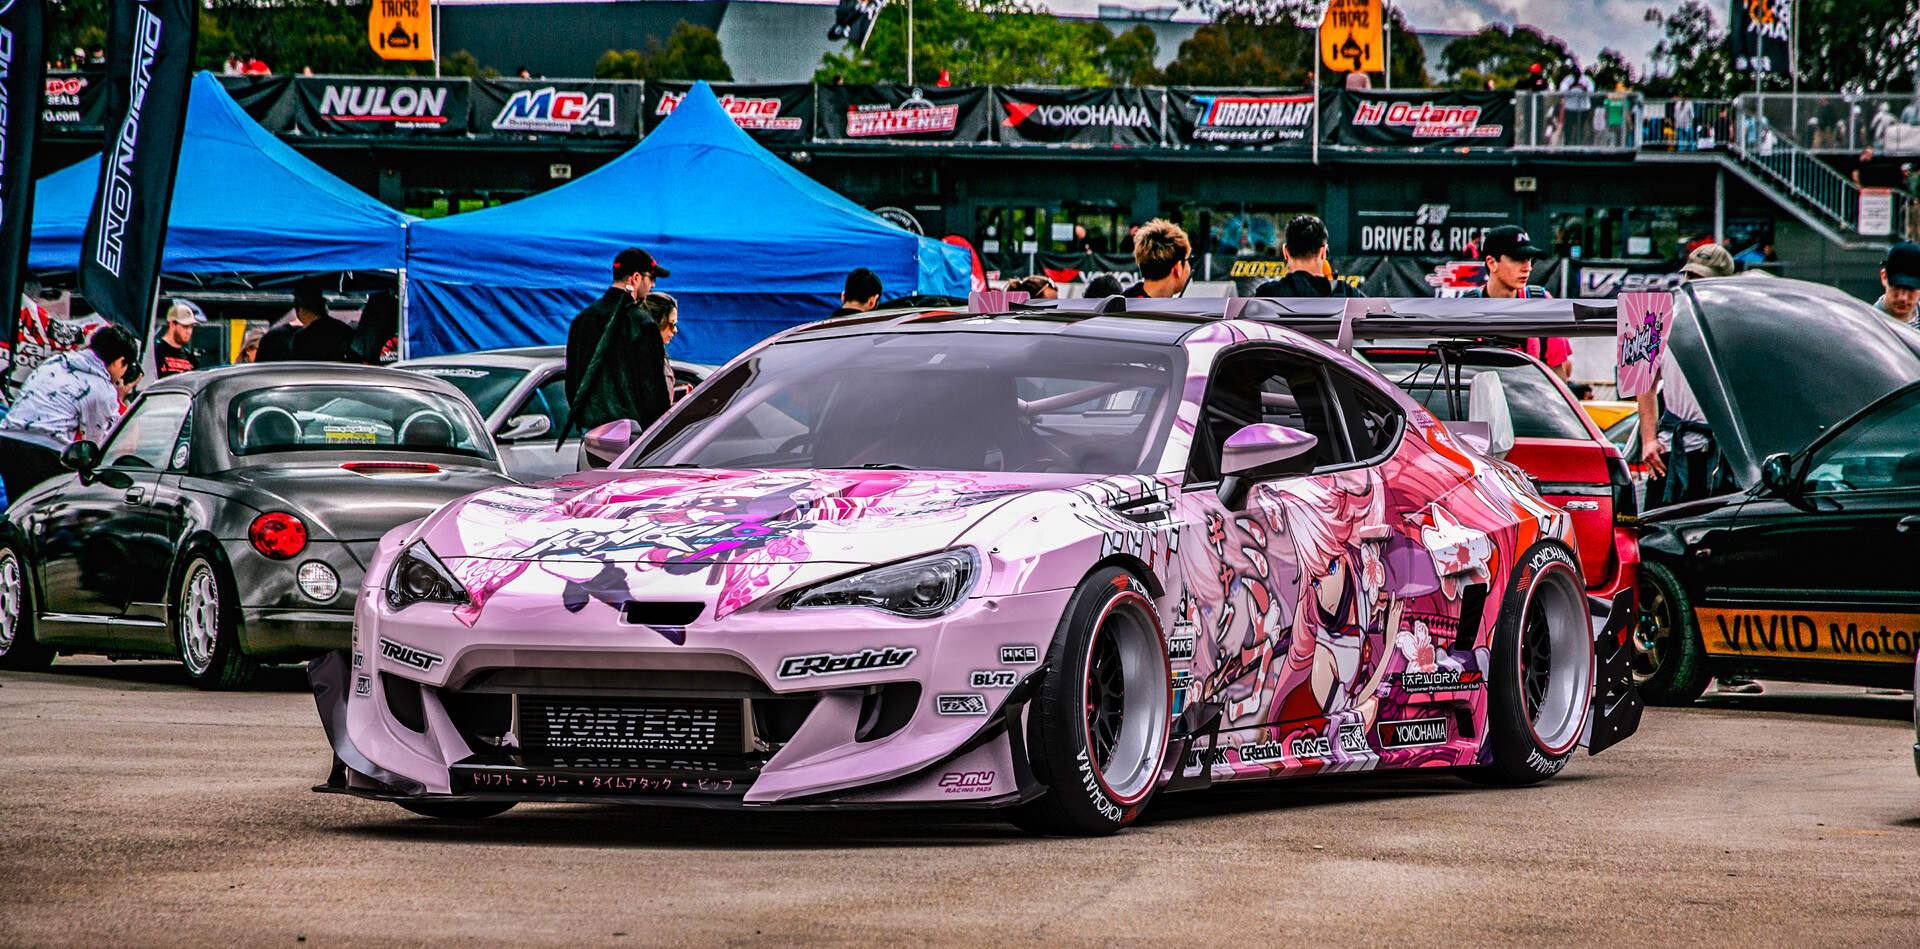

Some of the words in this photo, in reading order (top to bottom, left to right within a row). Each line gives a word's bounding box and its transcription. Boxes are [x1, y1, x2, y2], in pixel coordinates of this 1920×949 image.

[117, 10, 162, 177] DIVISION
[320, 85, 448, 116] NULON
[497, 89, 614, 126] MCA
[1038, 104, 1152, 127] YOKOHAMA
[1192, 95, 1314, 126] TURBOSMART
[1385, 101, 1481, 126] Octane
[850, 115, 954, 133] CHALLENGE
[98, 174, 132, 278] ONE
[1362, 226, 1425, 251] DRIVER
[1430, 229, 1444, 252] &
[1170, 639, 1193, 654] HKS
[1717, 614, 1819, 653] VIVID
[380, 638, 443, 669] TRUST
[778, 649, 913, 678] GReddy
[1002, 648, 1036, 660] HKS
[973, 673, 1015, 685] BLITZ
[546, 707, 718, 737] VORTECH
[1396, 722, 1447, 743] YOKOHAMA
[546, 737, 679, 749] SUPERCHARGERS
[1294, 740, 1329, 757] RAYS
[473, 773, 513, 786] ドリフト
[536, 775, 568, 786] ラリー
[592, 776, 671, 790] タイムアタック
[1076, 746, 1123, 822] YOKOHAMA
